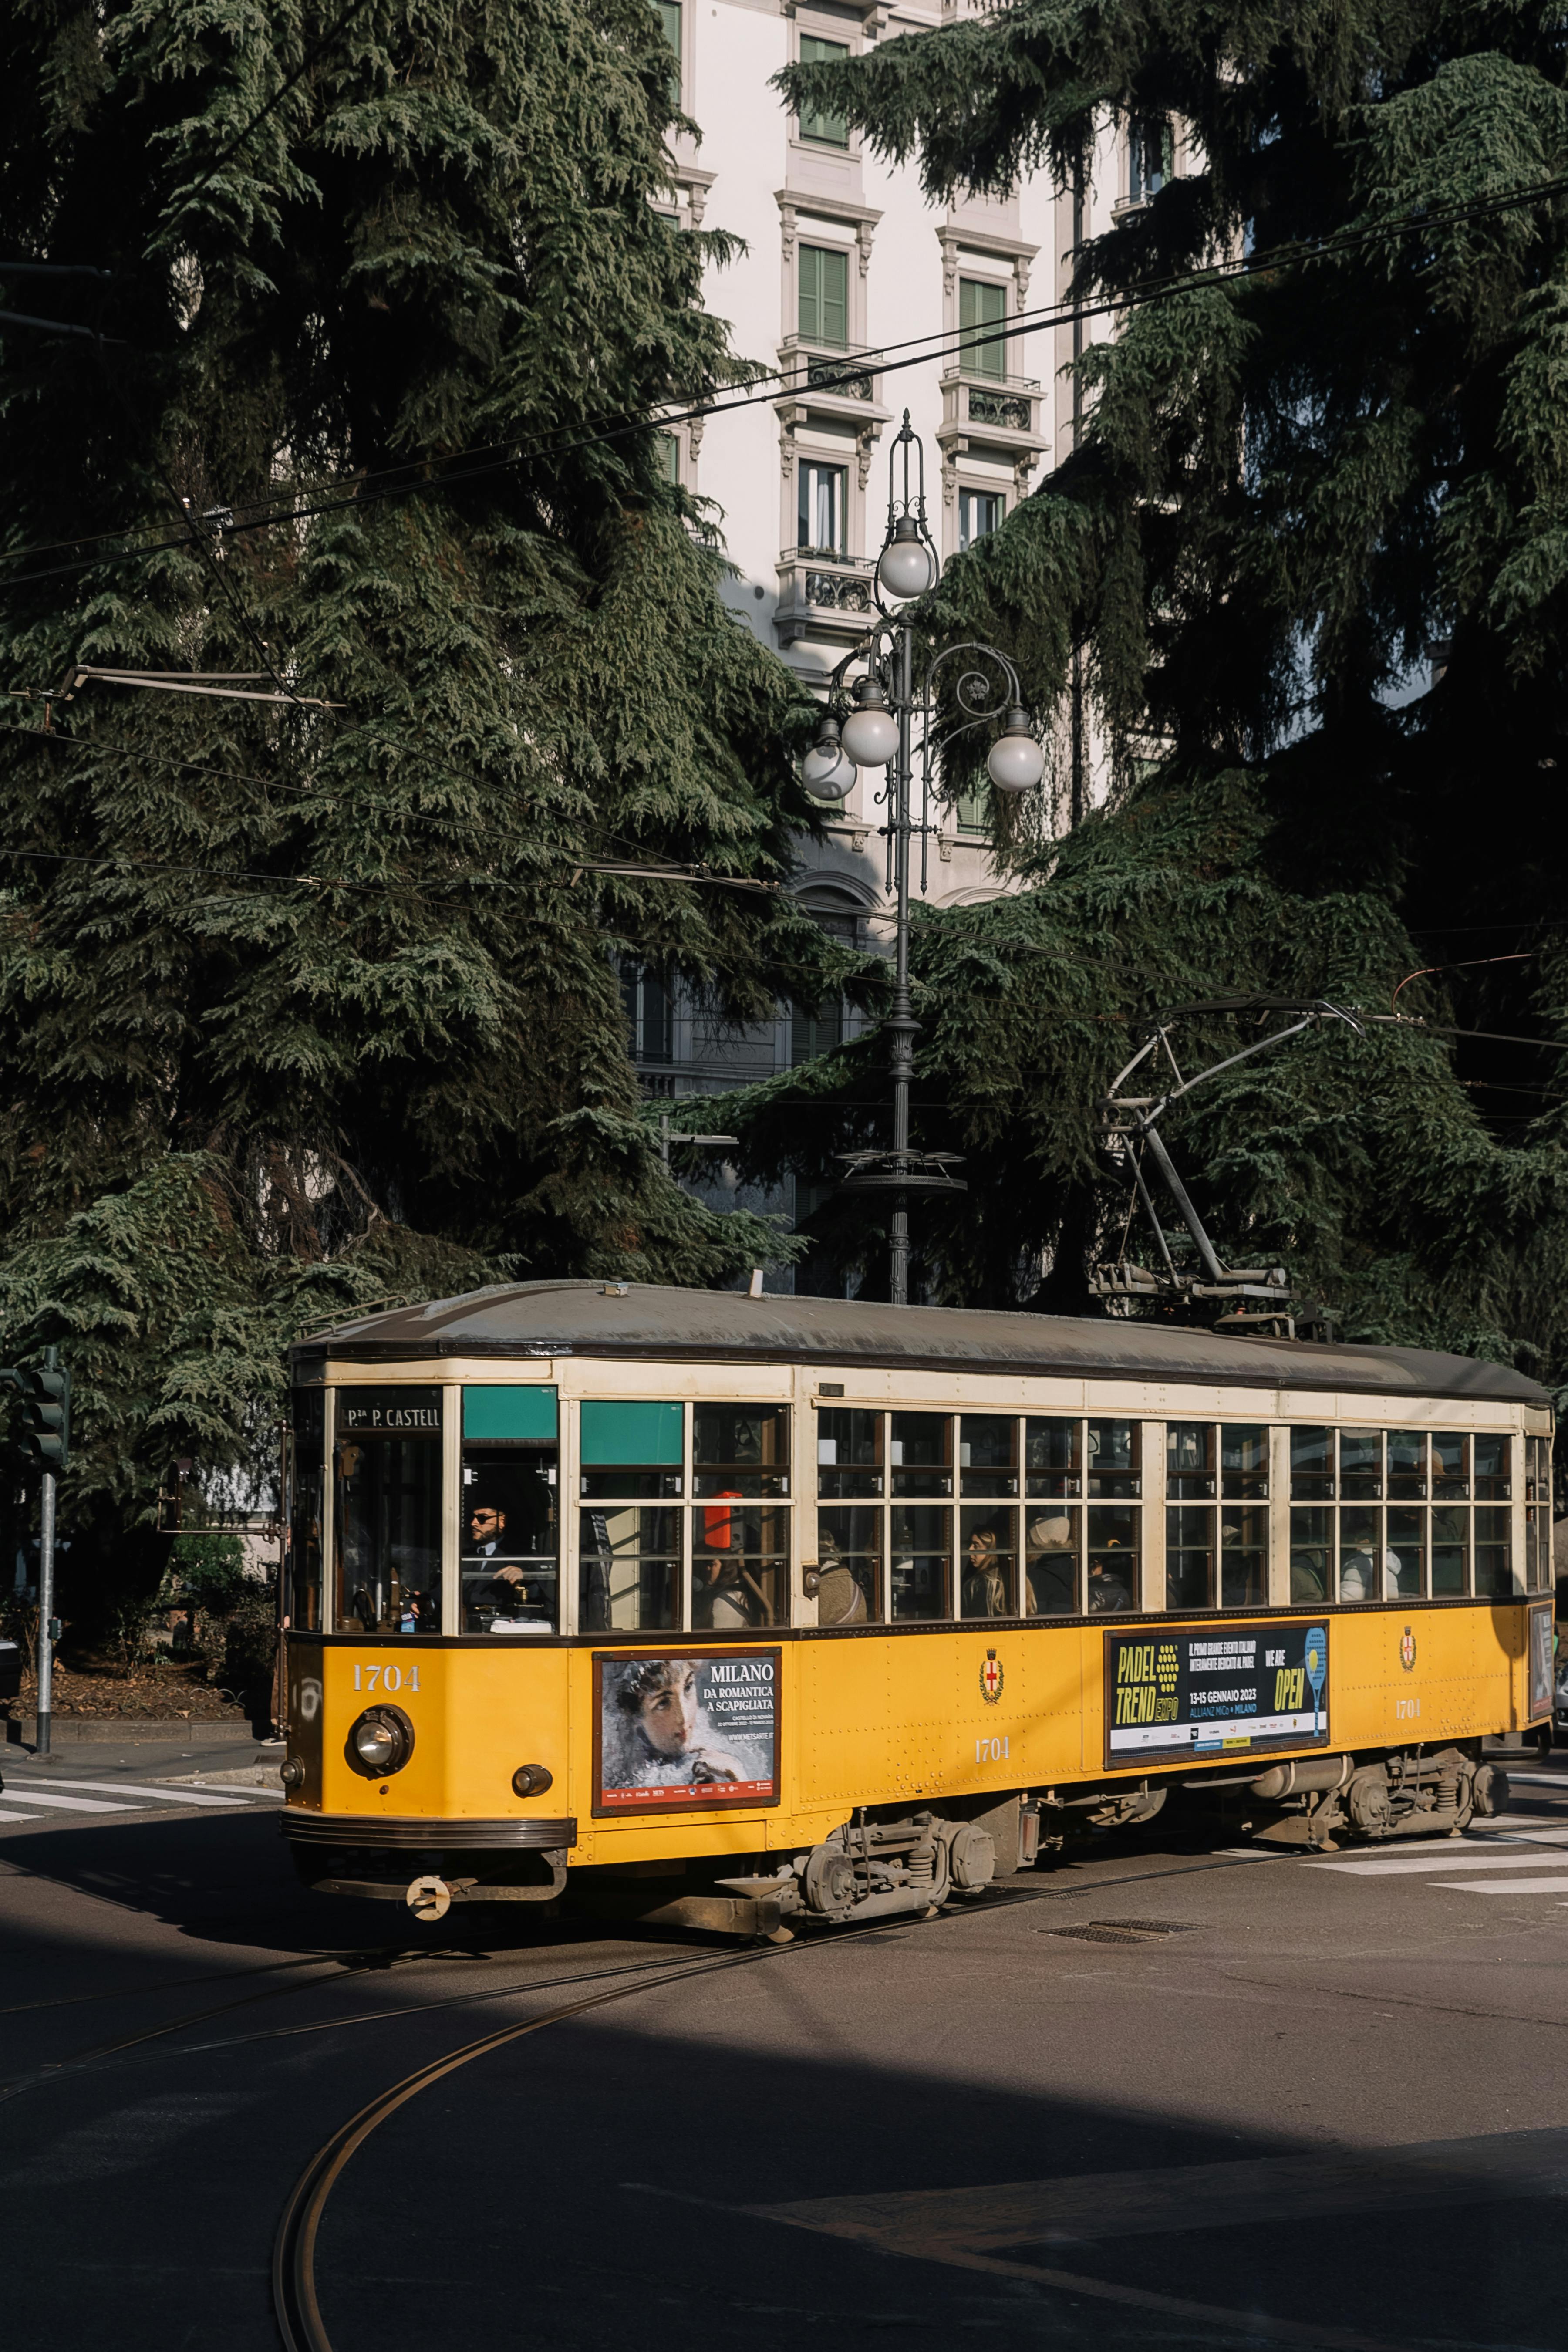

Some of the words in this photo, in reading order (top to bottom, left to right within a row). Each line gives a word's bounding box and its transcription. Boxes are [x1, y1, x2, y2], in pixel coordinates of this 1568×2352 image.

[1117, 1646, 1157, 1683] PADEL
[1265, 1650, 1275, 1667] WE
[1275, 1649, 1286, 1666] ARE
[353, 1664, 421, 1692] 1704
[710, 1664, 774, 1683] MILANO
[703, 1688, 718, 1699] DA
[718, 1686, 774, 1698] ROMANTICA
[1190, 1691, 1207, 1704] 13-15
[1207, 1689, 1239, 1703] GENNAIO
[1240, 1688, 1257, 1701] 2023
[1274, 1668, 1305, 1711] OPEN
[707, 1702, 715, 1712] A
[715, 1699, 774, 1711] SCAPIGLIATA
[1116, 1686, 1156, 1724] TREND
[1154, 1697, 1179, 1721] EXPO
[1190, 1706, 1215, 1718] ALLIANZ
[1234, 1703, 1257, 1714] MILANO
[1396, 1698, 1421, 1719] 1704
[975, 1736, 1010, 1764] 1704
